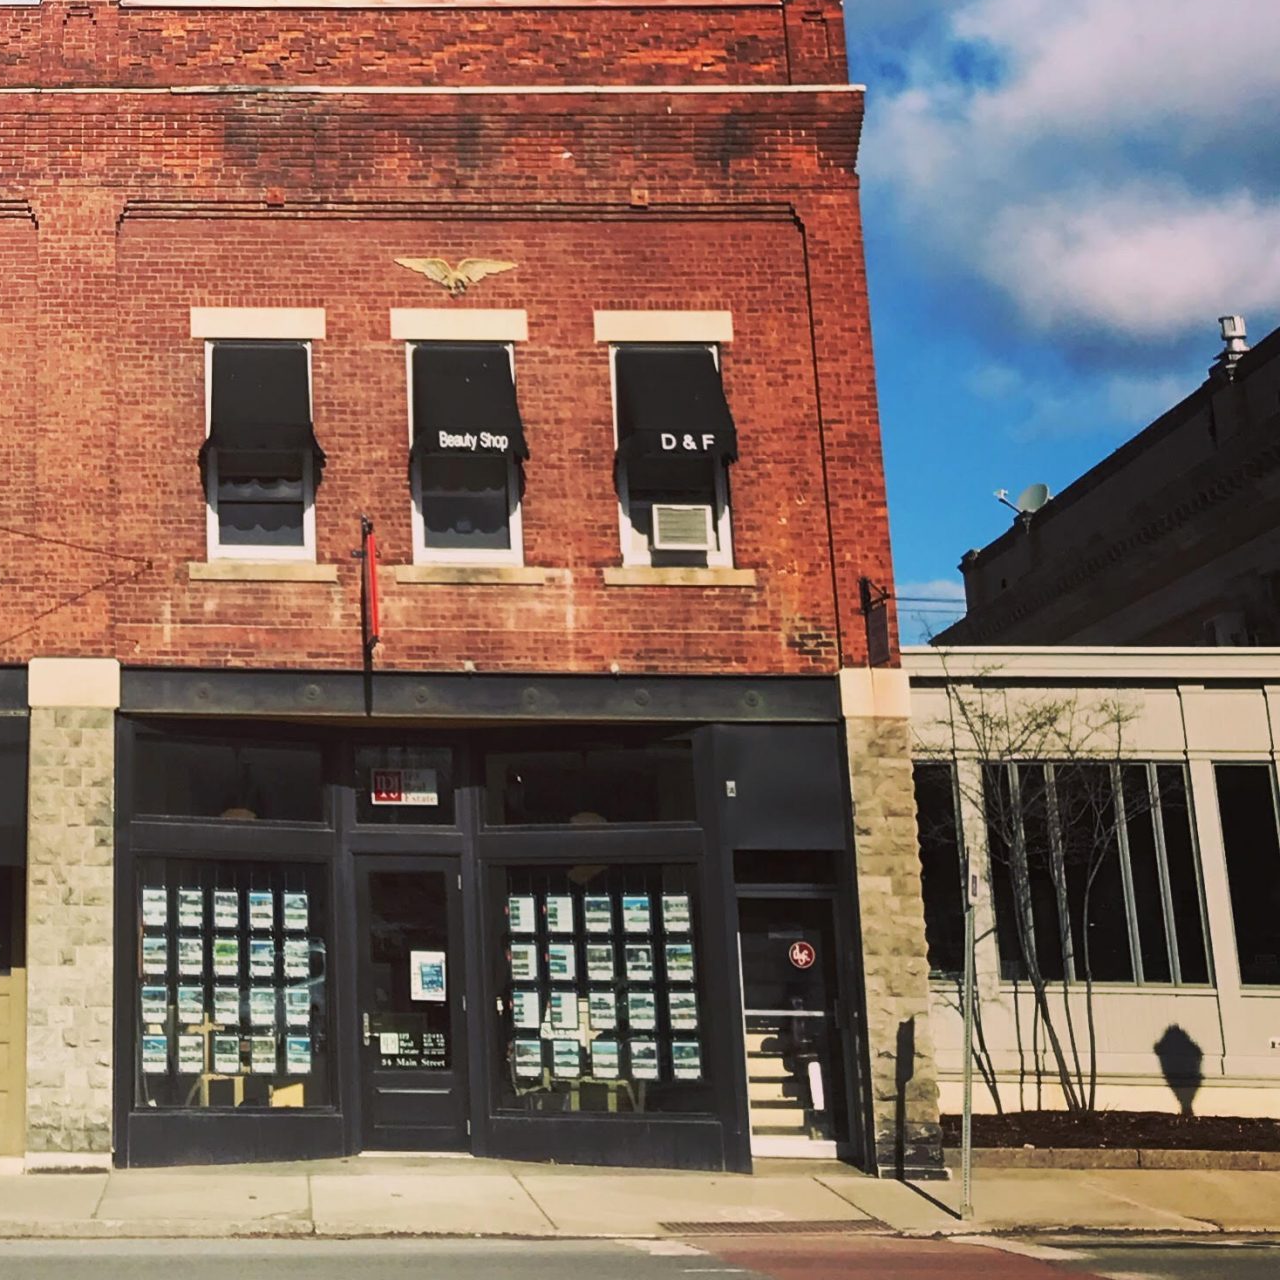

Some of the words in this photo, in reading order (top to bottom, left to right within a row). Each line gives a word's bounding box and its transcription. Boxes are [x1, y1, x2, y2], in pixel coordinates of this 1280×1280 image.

[438, 430, 478, 451] Beauty
[479, 431, 509, 452] Shop
[660, 433, 677, 450] D
[682, 434, 698, 451] &
[701, 434, 715, 451] F
[396, 1057, 418, 1067] Main
[420, 1058, 446, 1067] Street
